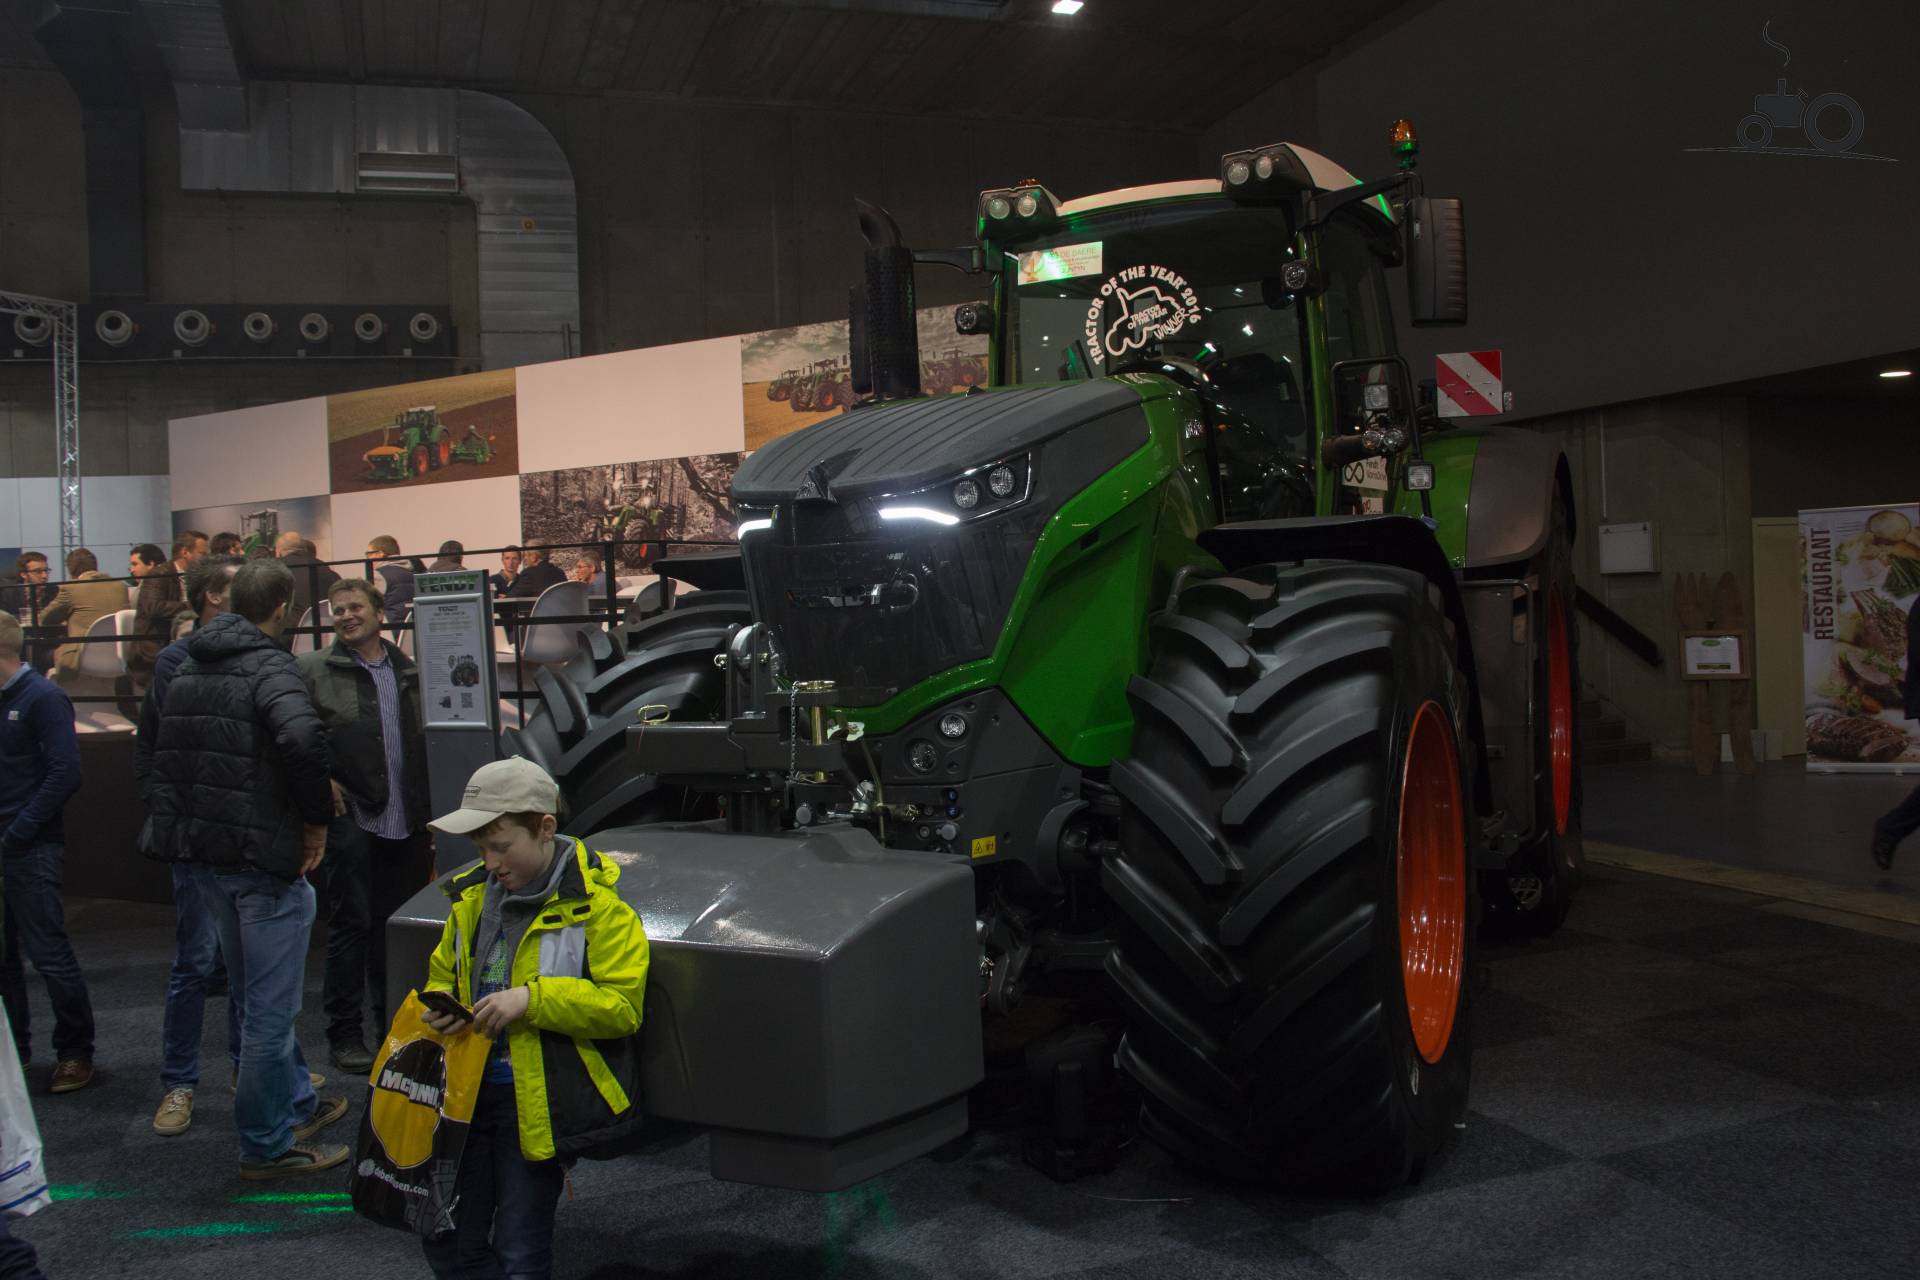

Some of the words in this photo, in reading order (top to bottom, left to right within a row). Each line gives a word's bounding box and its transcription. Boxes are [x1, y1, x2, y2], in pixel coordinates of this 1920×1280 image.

[1086, 297, 1105, 365] TRACTOR
[1101, 277, 1118, 296] OF
[1119, 265, 1146, 283] THE
[1150, 265, 1185, 290] YEAR
[1181, 287, 1202, 324] 2016
[1130, 304, 1161, 321] TRACTOR
[1151, 307, 1168, 320] YEAR
[1154, 308, 1188, 340] WINNER
[416, 574, 479, 593] FENDT
[1810, 528, 1835, 640] RESTAURANT
